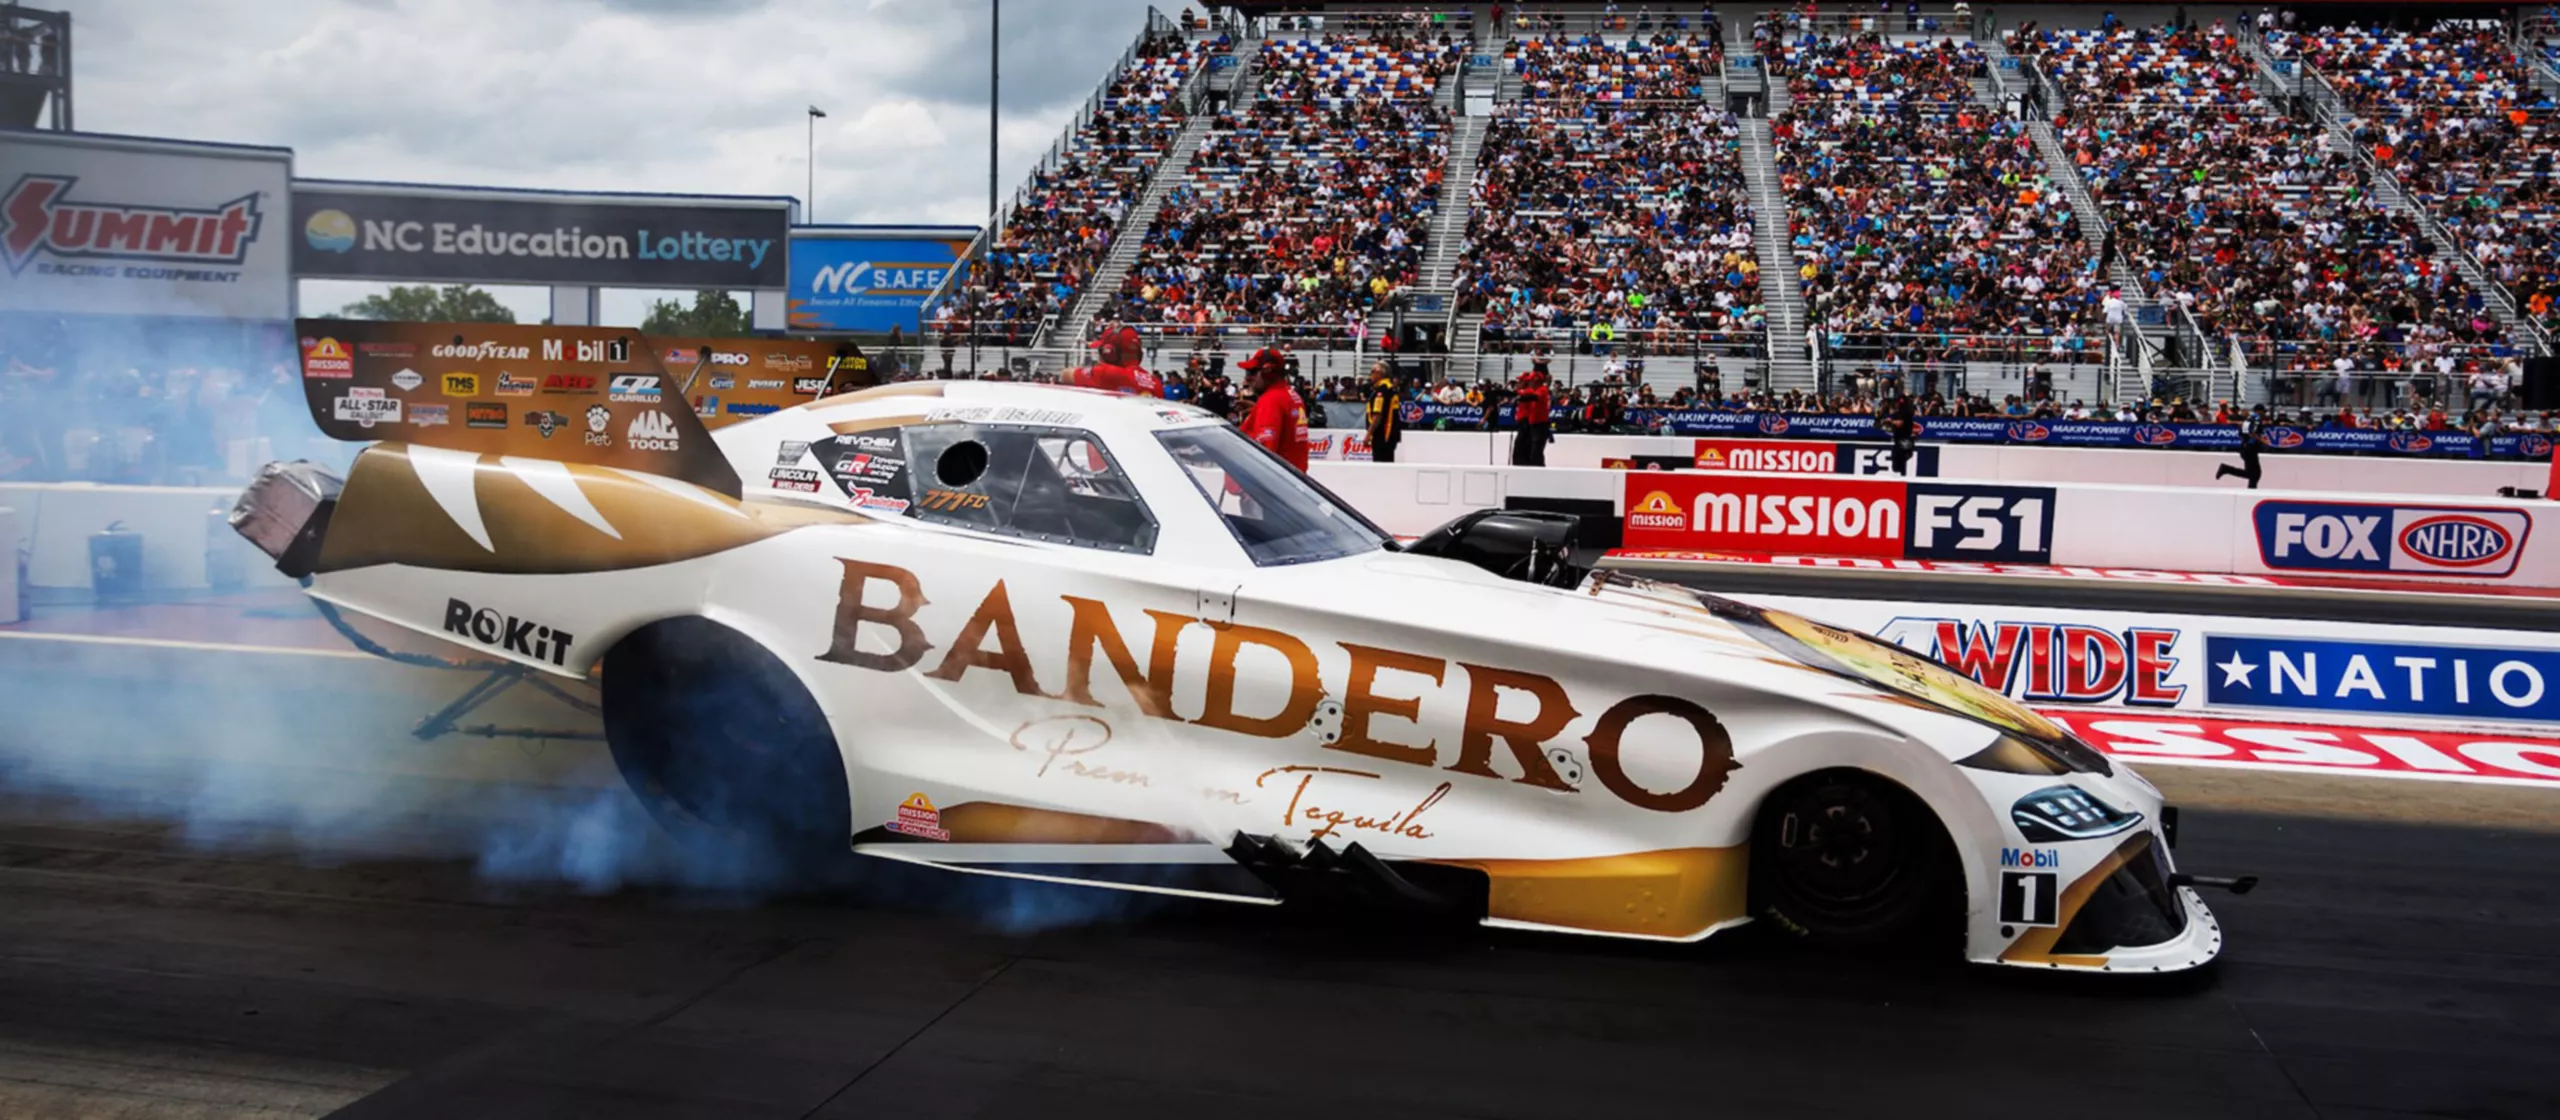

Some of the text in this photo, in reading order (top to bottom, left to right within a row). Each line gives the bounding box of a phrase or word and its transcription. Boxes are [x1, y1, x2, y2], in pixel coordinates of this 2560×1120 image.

[363, 220, 770, 269] NC Education Lottery
[37, 263, 241, 283] RACING EQUIPMENT
[812, 261, 872, 294] NC
[432, 342, 530, 361] GOODYEAR
[542, 339, 604, 362] Mobil
[308, 359, 350, 370] MISSION
[711, 353, 749, 365] PRO
[446, 376, 475, 389] TMS
[543, 375, 598, 389] ARP
[609, 393, 661, 403] CARRILLO
[628, 410, 679, 439] MAC
[1710, 413, 1755, 424] POWER!
[1790, 416, 1875, 428] MAKIN' POWER
[1926, 420, 2005, 431] MAKIN' POWER!
[2052, 424, 2131, 435] MAKIN' POWER!
[2179, 428, 2239, 438] MAKIN' POW
[2306, 431, 2386, 442] MAKIN' POWER!
[584, 432, 612, 447] Pet
[628, 439, 679, 451] TOOLS
[834, 459, 864, 474] GR
[872, 456, 905, 466] TOYOTA
[1729, 447, 1835, 472] MISSION
[771, 468, 816, 482] LINCOLN
[775, 481, 815, 493] WELDERS
[1631, 515, 1683, 528] MISSION
[1692, 491, 1900, 539] MISSION
[1914, 494, 2043, 553] FS1
[2274, 512, 2381, 561] FOX
[2414, 521, 2498, 560] NHRA
[815, 556, 1744, 812] BANDERO
[1257, 765, 1453, 840] Tequila
[899, 806, 938, 820] MISSION
[2001, 847, 2059, 868] Mobil
